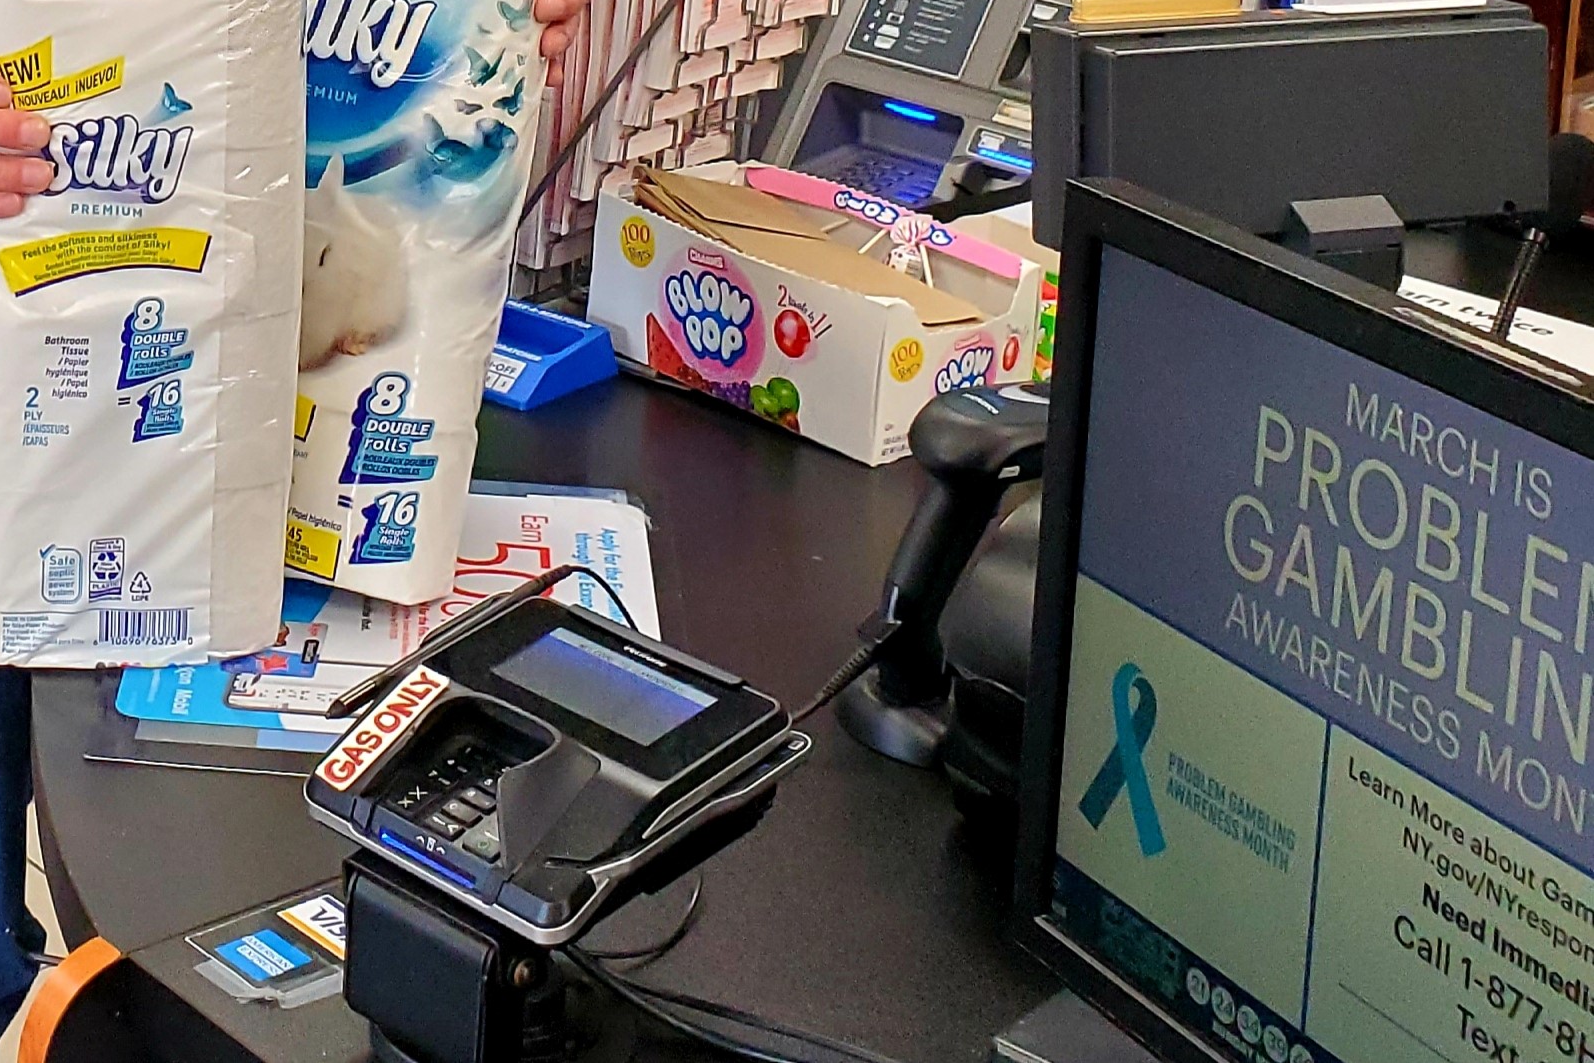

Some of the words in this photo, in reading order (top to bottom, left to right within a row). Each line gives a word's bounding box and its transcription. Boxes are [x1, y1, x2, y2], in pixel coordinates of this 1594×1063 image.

[48, 113, 194, 204] Silky
[70, 203, 144, 218] PREMIUM
[22, 247, 42, 260] Feel
[42, 243, 57, 255] the
[58, 235, 96, 252] softness
[98, 233, 115, 244] and
[117, 231, 158, 243] silkiness
[621, 224, 651, 245] 100
[56, 247, 75, 261] with
[76, 245, 92, 257] the
[93, 241, 128, 253] comfort
[129, 240, 141, 251] of
[143, 239, 171, 251] Silky!
[665, 269, 755, 325] BLOW
[777, 284, 789, 309] 2
[133, 298, 163, 332] 8
[44, 335, 90, 346] Bathroom
[61, 346, 90, 356] Tissue
[133, 331, 185, 346] DOUBLE
[682, 317, 748, 367] POP
[889, 338, 919, 367] 100
[133, 346, 169, 361] rolls
[935, 345, 995, 395] BLOW
[25, 386, 39, 408] 2
[148, 379, 181, 407] 16
[367, 374, 407, 416] 8
[24, 410, 43, 422] PLY
[364, 419, 431, 437] DOUBLE
[363, 437, 409, 453] rolls
[1345, 381, 1500, 496] MARCH
[1514, 459, 1554, 520] IS
[378, 492, 418, 526] 16
[377, 526, 410, 537] Single
[520, 514, 549, 543] Earn
[48, 568, 76, 579] septic
[49, 554, 76, 567] Safe
[130, 594, 149, 602] LDPE
[1223, 494, 1594, 766] GAMBLIN
[323, 730, 381, 783] GAS
[372, 668, 443, 734] ONLY
[1225, 592, 1462, 761] AWARENESS
[1476, 729, 1594, 836] MON
[1168, 751, 1227, 802] PROBLEM
[1228, 788, 1296, 851] GAMBLING
[1166, 777, 1239, 842] AWARENESS
[1241, 825, 1290, 874] MONTH
[1348, 755, 1404, 810] Learn
[1410, 788, 1466, 847] More
[1470, 825, 1536, 893] about
[309, 905, 346, 942] VIS
[1422, 881, 1486, 941] Need
[244, 935, 291, 970] AMERICAN
[1393, 913, 1451, 977] Call
[238, 946, 281, 976] EXPRESS
